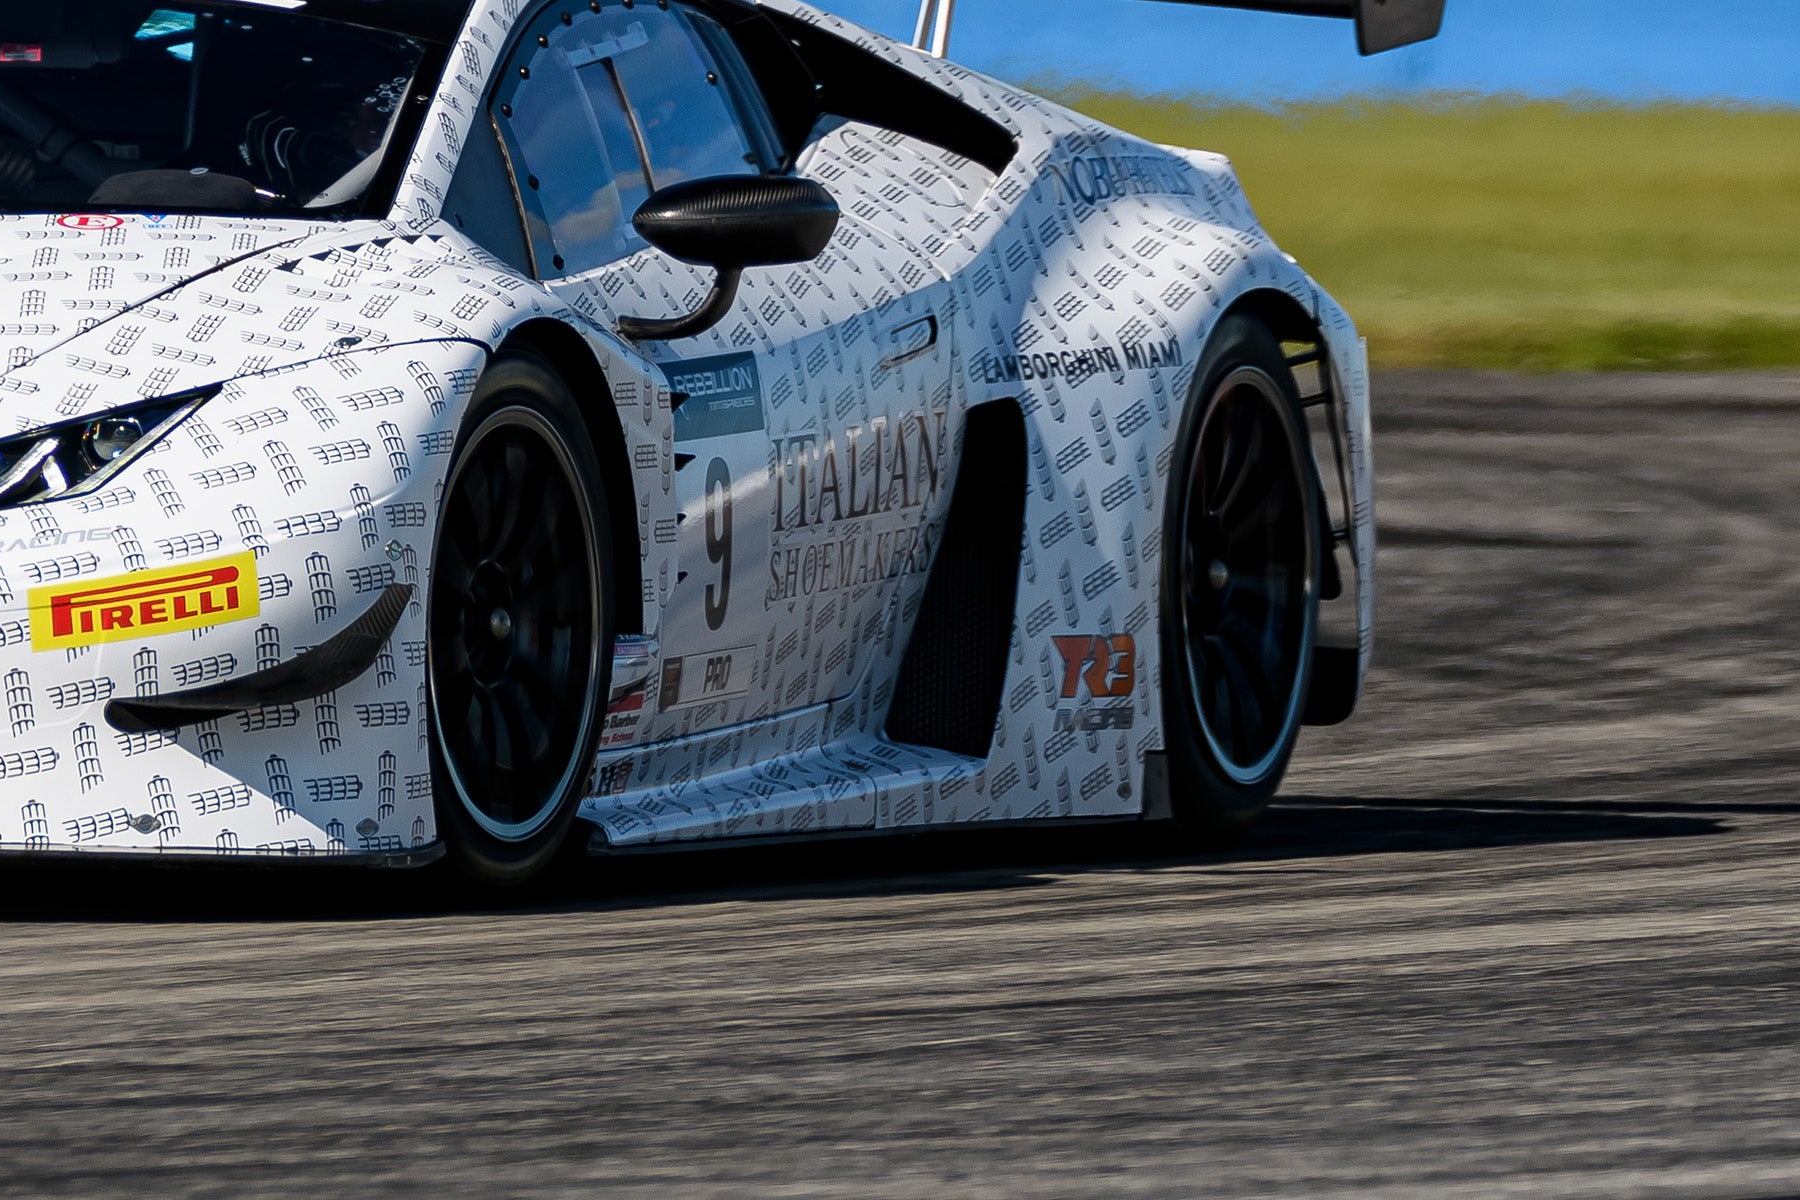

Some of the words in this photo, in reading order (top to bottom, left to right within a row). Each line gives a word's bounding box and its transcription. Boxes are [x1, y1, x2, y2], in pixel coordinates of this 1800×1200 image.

[673, 367, 753, 397] REBELLION
[1122, 340, 1183, 370] MIAMI
[771, 408, 945, 532] ITALIAN
[705, 457, 732, 630] 9
[769, 522, 938, 601] SHOEMAKERS
[50, 566, 240, 638] PIRELLI
[702, 654, 732, 694] PRO
[1052, 633, 1136, 699] TR3
